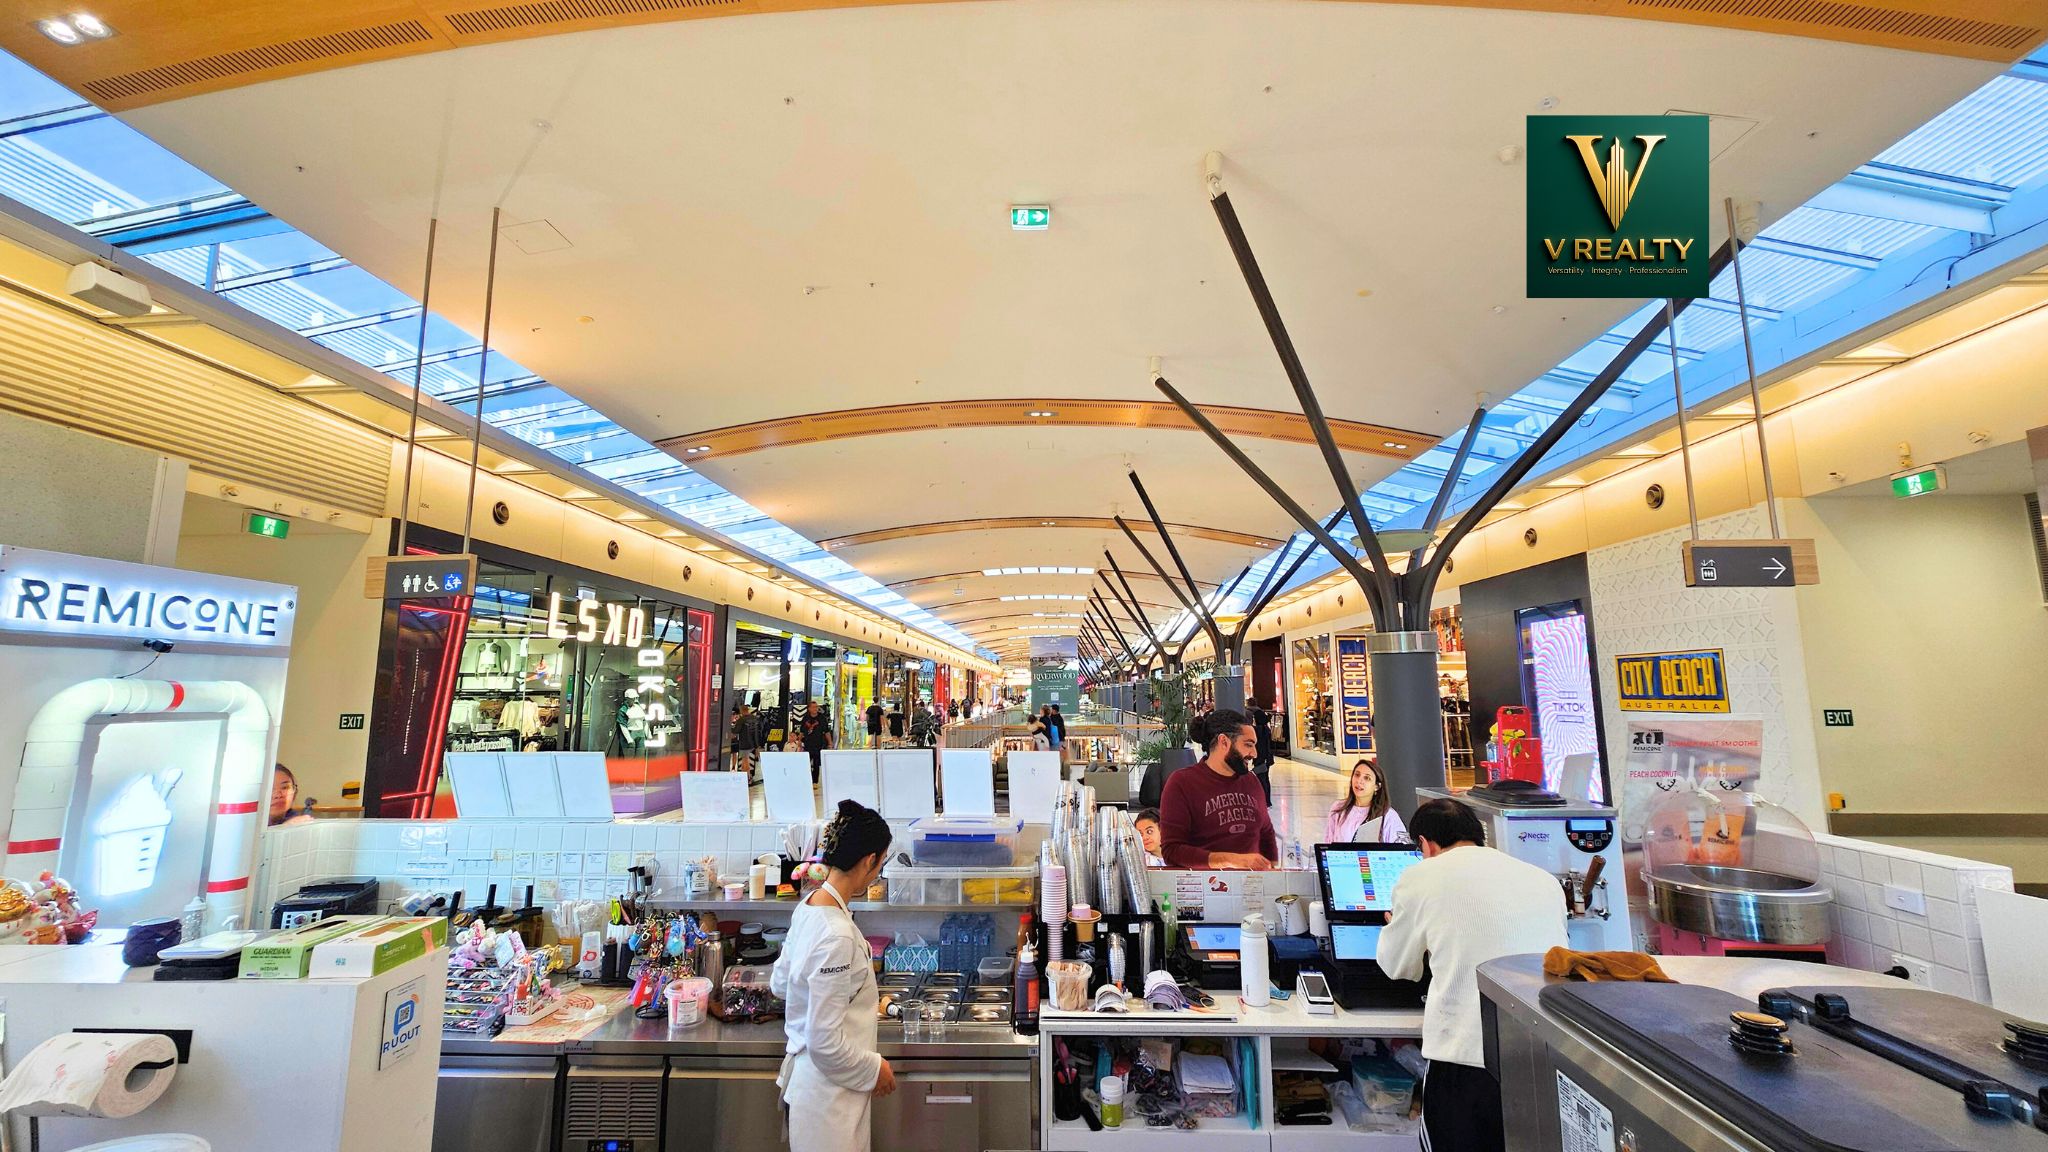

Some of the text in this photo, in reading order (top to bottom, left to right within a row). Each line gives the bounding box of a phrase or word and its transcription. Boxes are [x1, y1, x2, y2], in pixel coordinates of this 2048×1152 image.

[15, 578, 280, 637] REMICONE
[1033, 672, 1076, 682] RIVERWOOD
[1620, 657, 1718, 696] CITY BEACH
[1341, 654, 1370, 736] CITY BEACH
[1552, 702, 1587, 713] TIKTOK
[1625, 702, 1721, 710] AUSTRALIA
[340, 716, 363, 728] EXIT
[1826, 711, 1851, 725] EXIT
[1629, 770, 1678, 778] PEACH COCONUT
[1218, 807, 1256, 826] EAGLE
[253, 947, 292, 956] GUARDIAN
[820, 963, 851, 974] REMICONE
